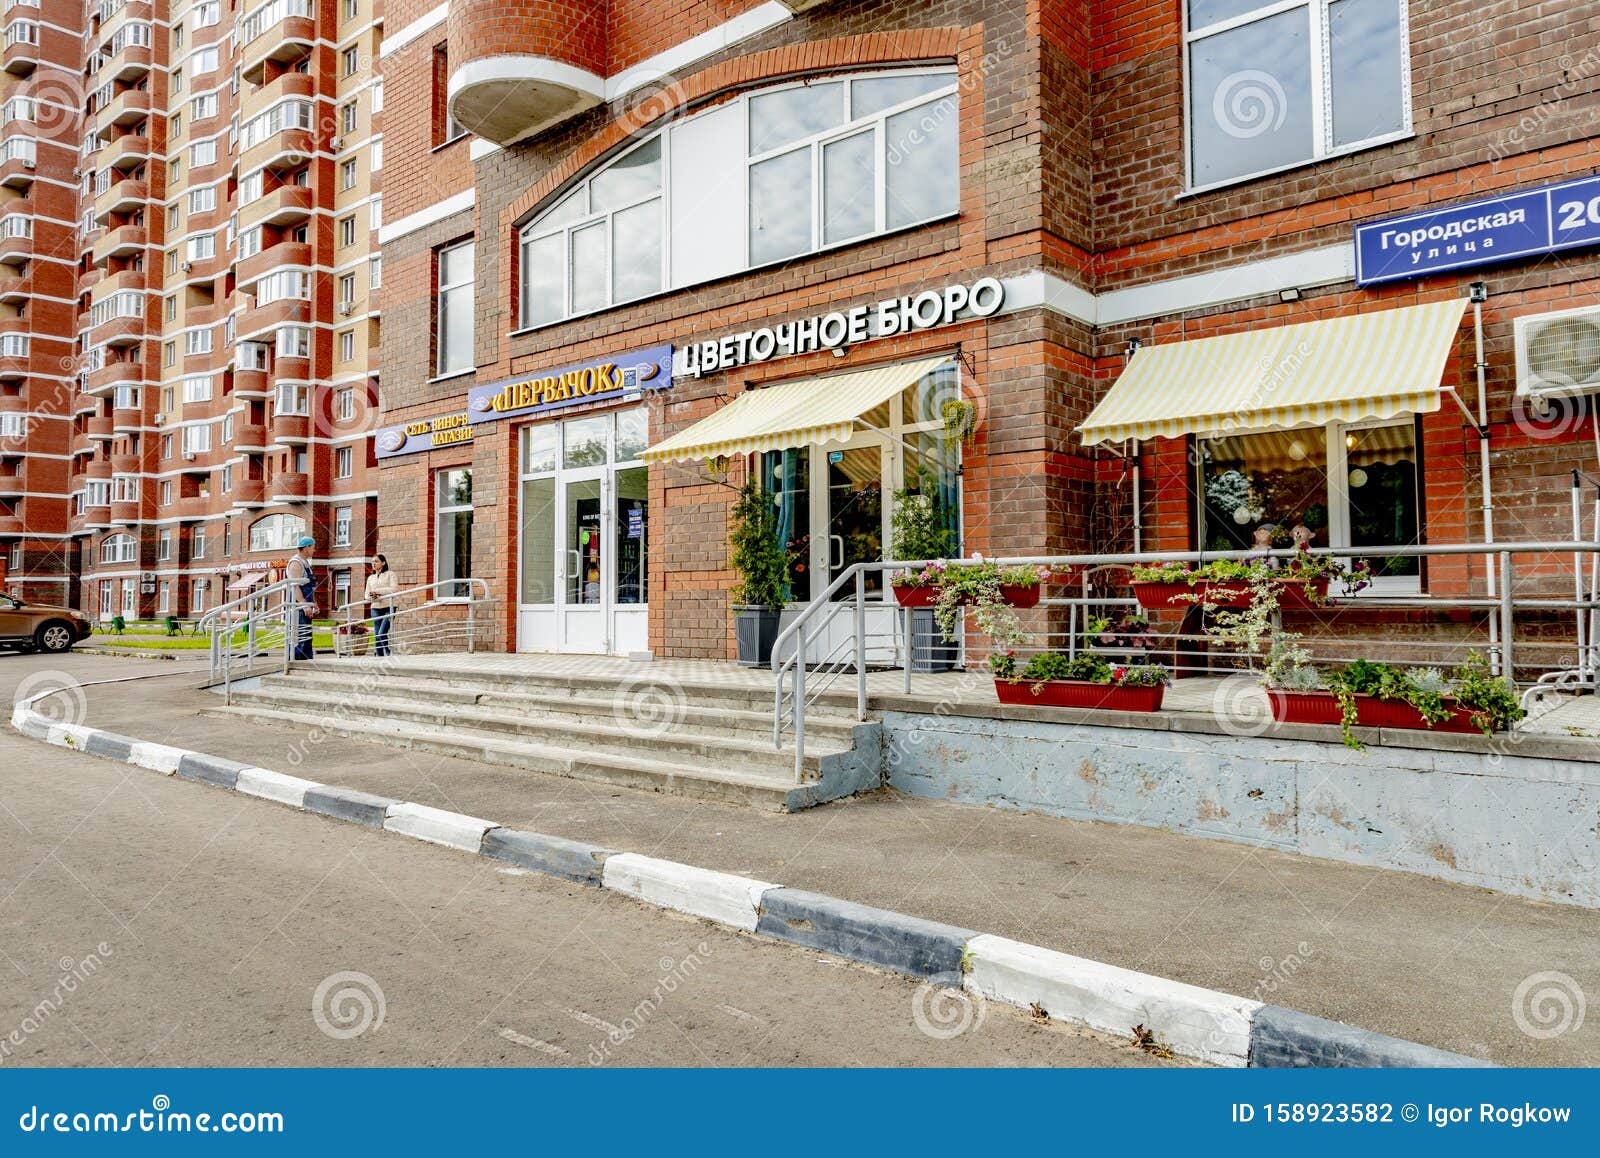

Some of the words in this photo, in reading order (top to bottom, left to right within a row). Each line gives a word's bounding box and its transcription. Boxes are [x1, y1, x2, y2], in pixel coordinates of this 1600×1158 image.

[1381, 208, 1525, 250] Городская
[1411, 237, 1494, 264] улица
[681, 305, 871, 379] ЦВЕТОЧНОЕ
[878, 277, 1005, 338] БЮРО
